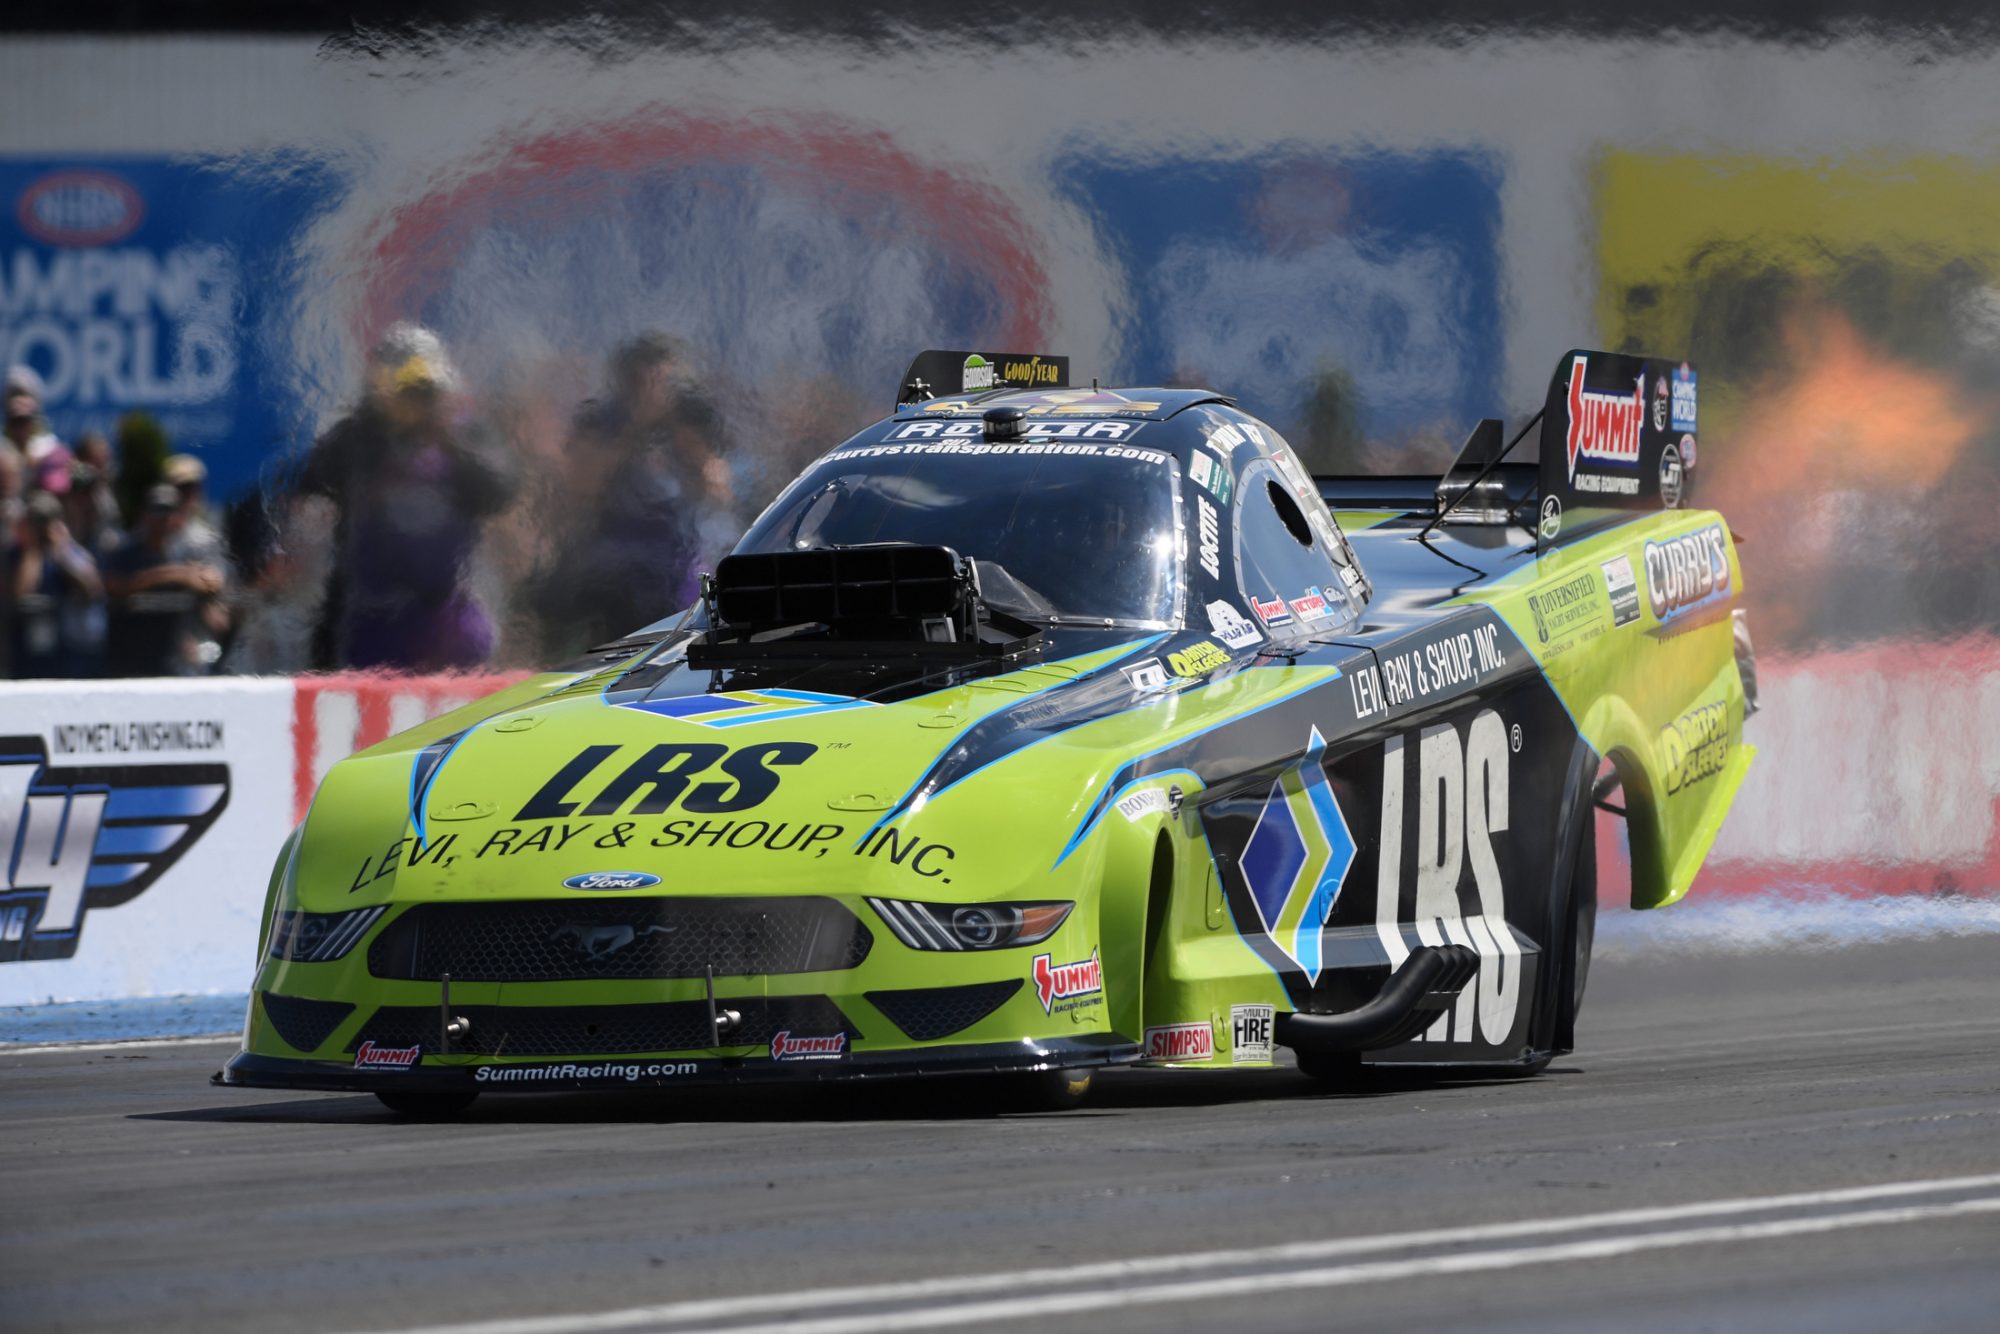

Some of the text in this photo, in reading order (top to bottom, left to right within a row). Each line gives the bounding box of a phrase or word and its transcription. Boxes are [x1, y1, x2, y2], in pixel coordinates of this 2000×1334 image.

[0, 319, 240, 402] ORLD
[1601, 475, 1640, 495] EQUIPMENT
[1198, 494, 1220, 581] LOCTITE
[1645, 526, 1729, 619] CURRY'S
[1540, 573, 1596, 615] DIVERSIFIED
[1385, 653, 1414, 706] RAY
[1413, 650, 1431, 695] &
[1426, 633, 1480, 690] SHOUP,
[1473, 623, 1506, 673] INC.
[511, 741, 819, 822] LRS
[349, 820, 956, 894] LEVI, RAY & SHOUP, INC.
[580, 872, 644, 888] Ford
[1032, 949, 1102, 1016] SUMMIT
[1233, 1014, 1271, 1049] FIRE
[1243, 1008, 1270, 1018] MULTI
[353, 1040, 420, 1069] SUMMIT
[771, 1030, 846, 1060] SUMMIT
[1151, 1029, 1211, 1058] SIMPSON
[474, 1062, 699, 1082] SummitRacing.com
